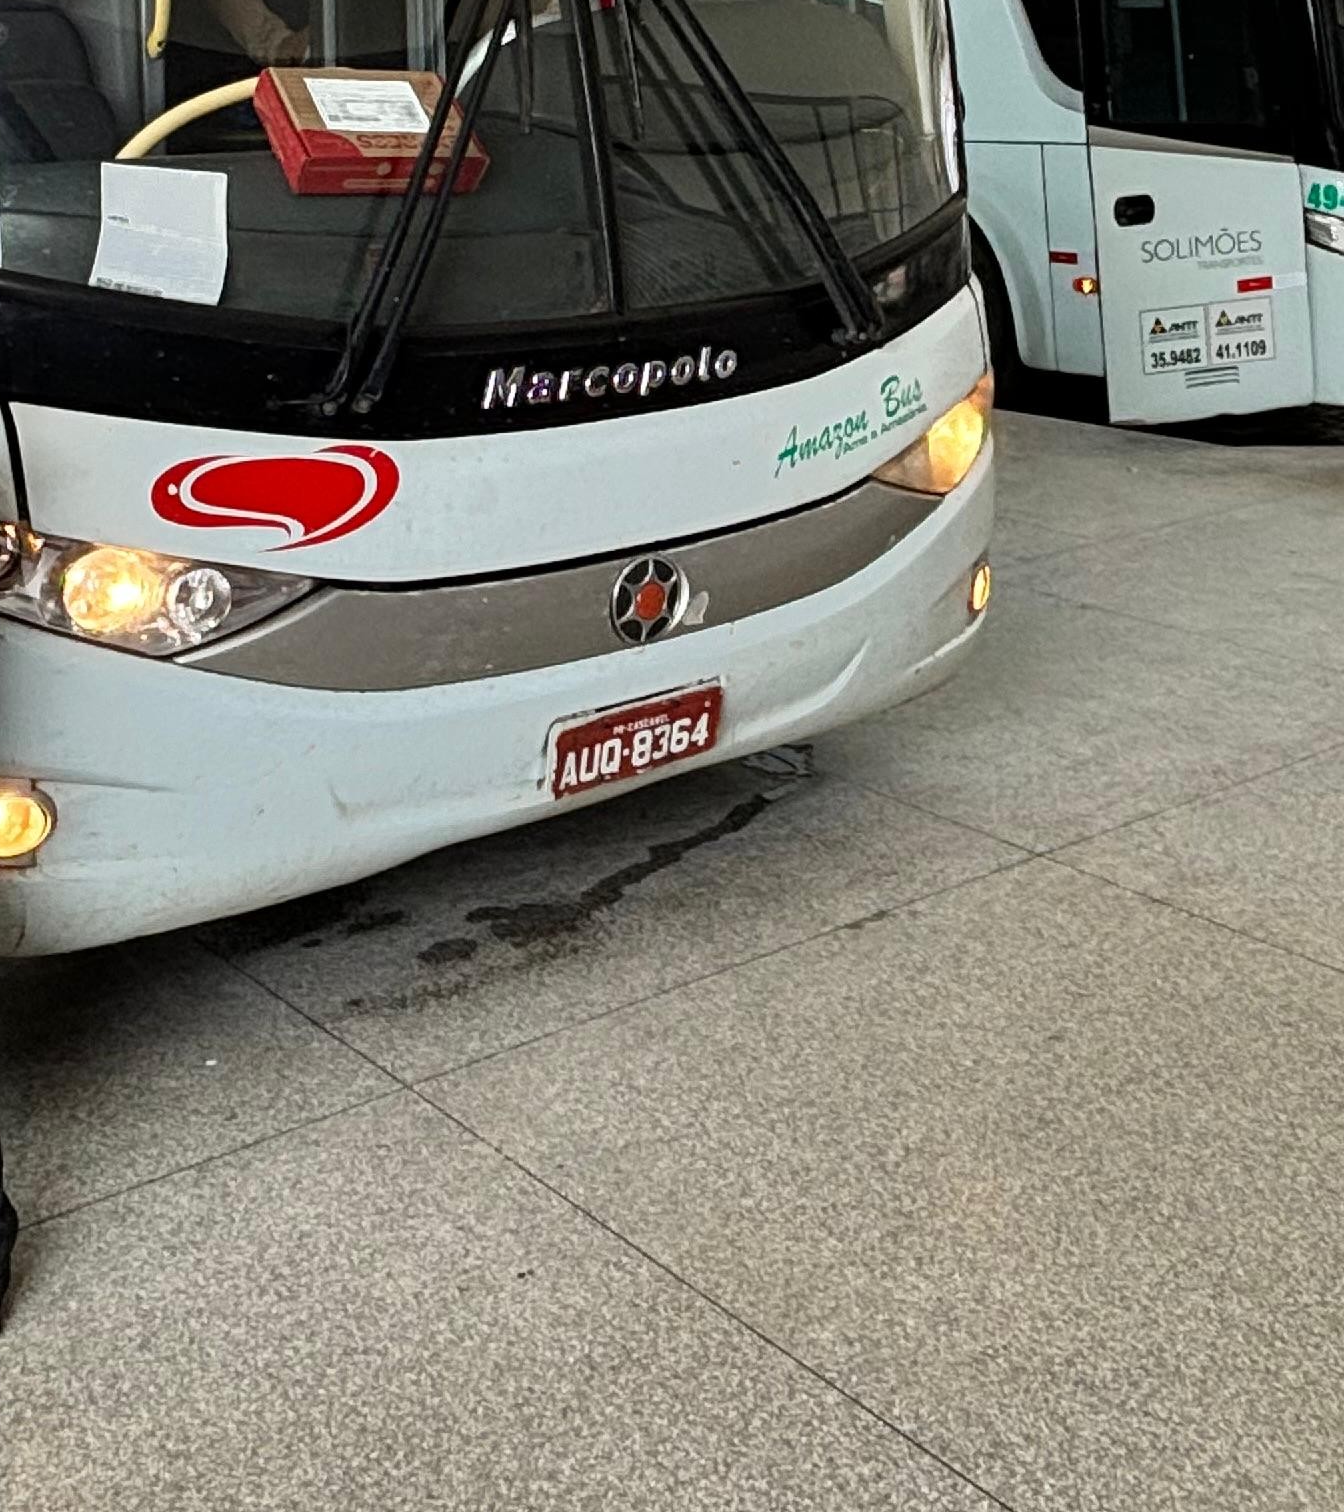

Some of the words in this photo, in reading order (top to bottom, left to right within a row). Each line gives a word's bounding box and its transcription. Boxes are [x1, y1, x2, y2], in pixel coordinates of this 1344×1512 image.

[1140, 228, 1263, 264] SOLIMÕES
[481, 345, 738, 410] Marcopolo
[1215, 339, 1267, 359] 41.1109
[774, 410, 869, 478] Amazon
[880, 375, 924, 417] Bus
[558, 712, 710, 790] AUQ-8364
